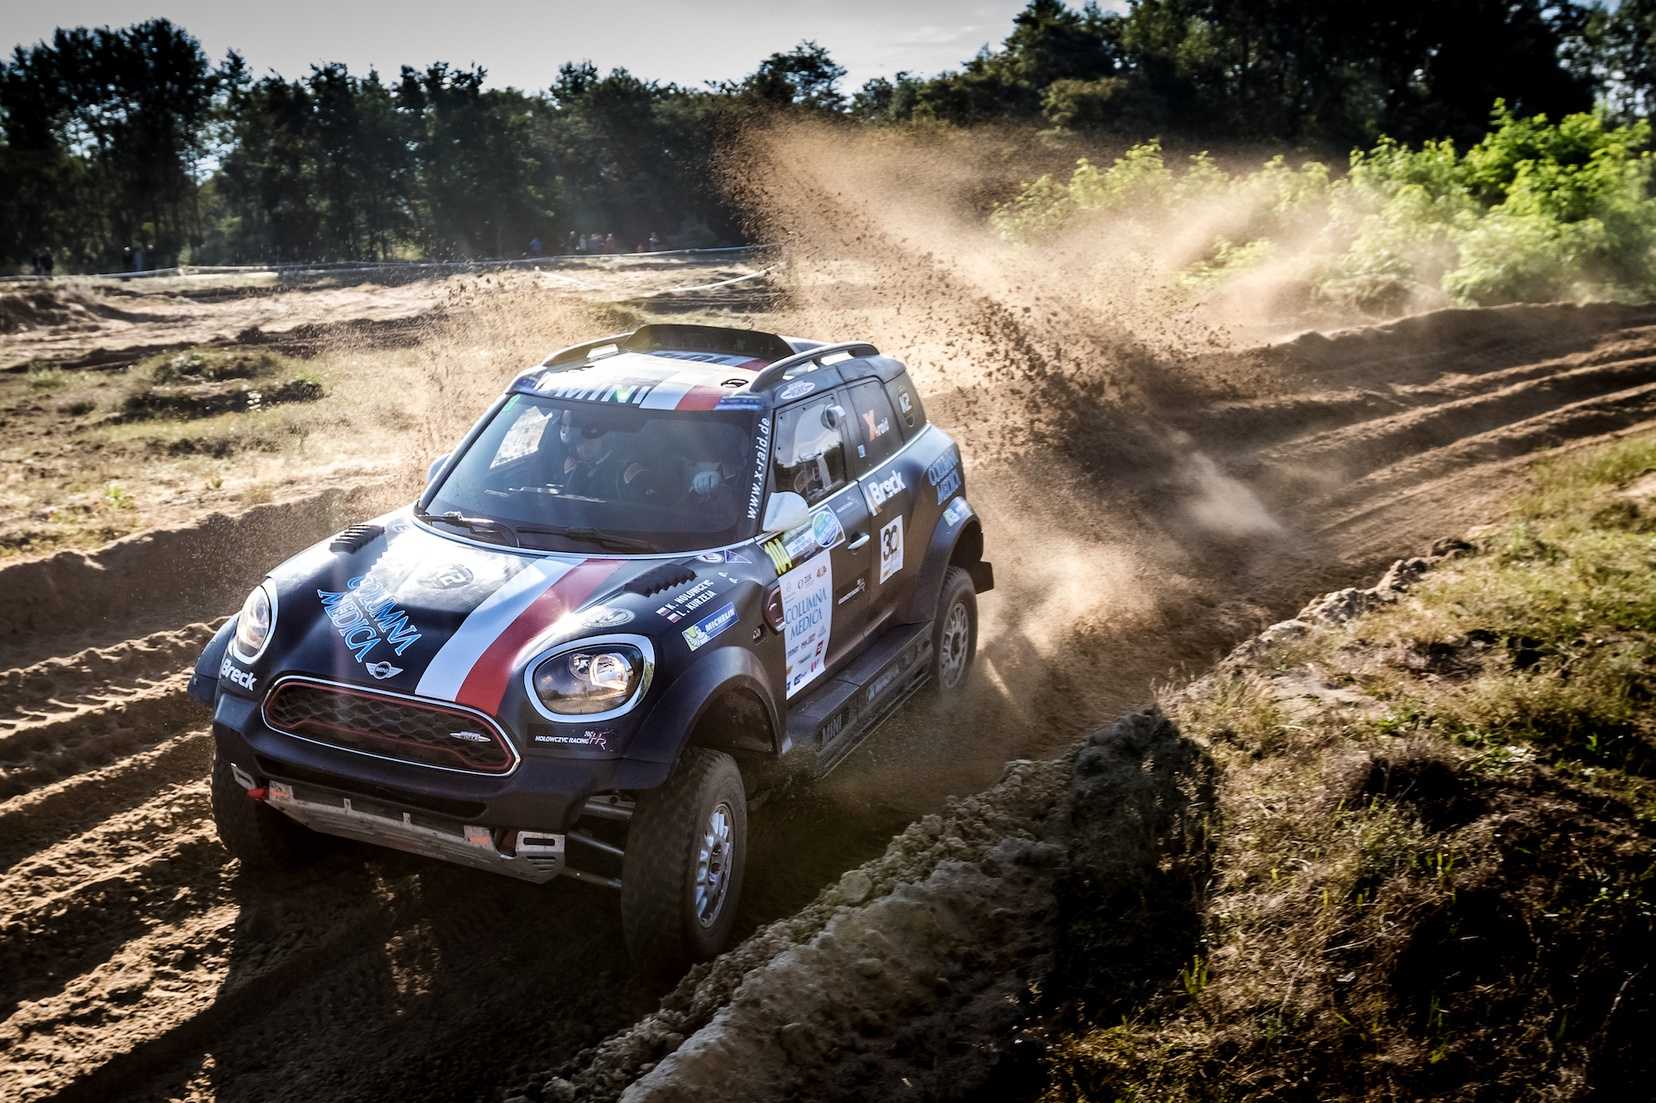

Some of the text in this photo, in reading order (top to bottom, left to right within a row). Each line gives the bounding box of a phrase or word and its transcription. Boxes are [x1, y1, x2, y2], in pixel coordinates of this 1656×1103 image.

[747, 417, 770, 520] www.x-raid.de
[867, 469, 907, 505] Breck
[346, 574, 423, 657] COLUMNA
[704, 607, 736, 633] MICHELIN
[785, 586, 828, 625] COLUMNA
[316, 589, 382, 664] MEDICA
[790, 607, 823, 641] MEDICA
[220, 658, 258, 692] Breck
[568, 737, 590, 745] RACING
